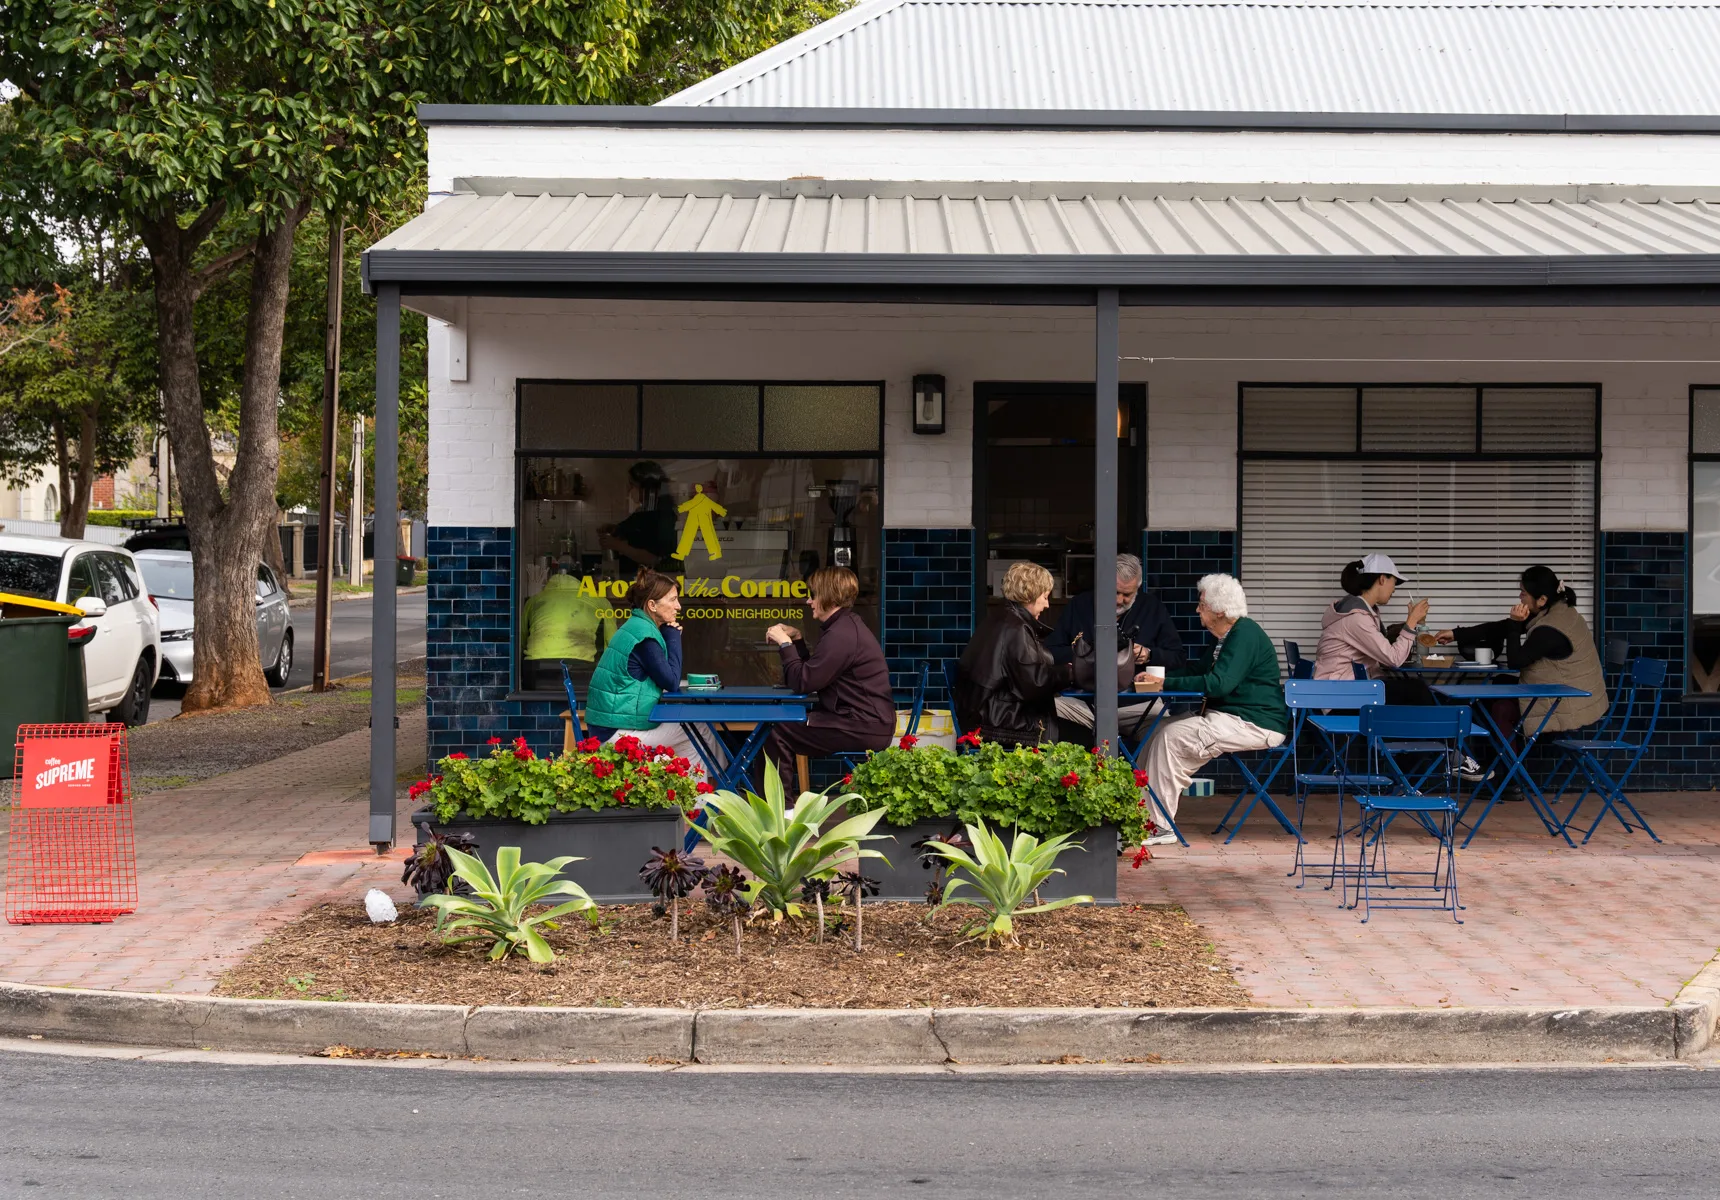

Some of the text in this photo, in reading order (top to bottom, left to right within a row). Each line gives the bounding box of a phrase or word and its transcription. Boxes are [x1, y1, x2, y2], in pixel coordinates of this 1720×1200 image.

[577, 575, 811, 598] Aro the Corne
[595, 608, 633, 619] GOOD
[686, 608, 724, 619] GOOD
[726, 608, 804, 619] NEIGHBOURS
[35, 758, 95, 790] SUPREME
